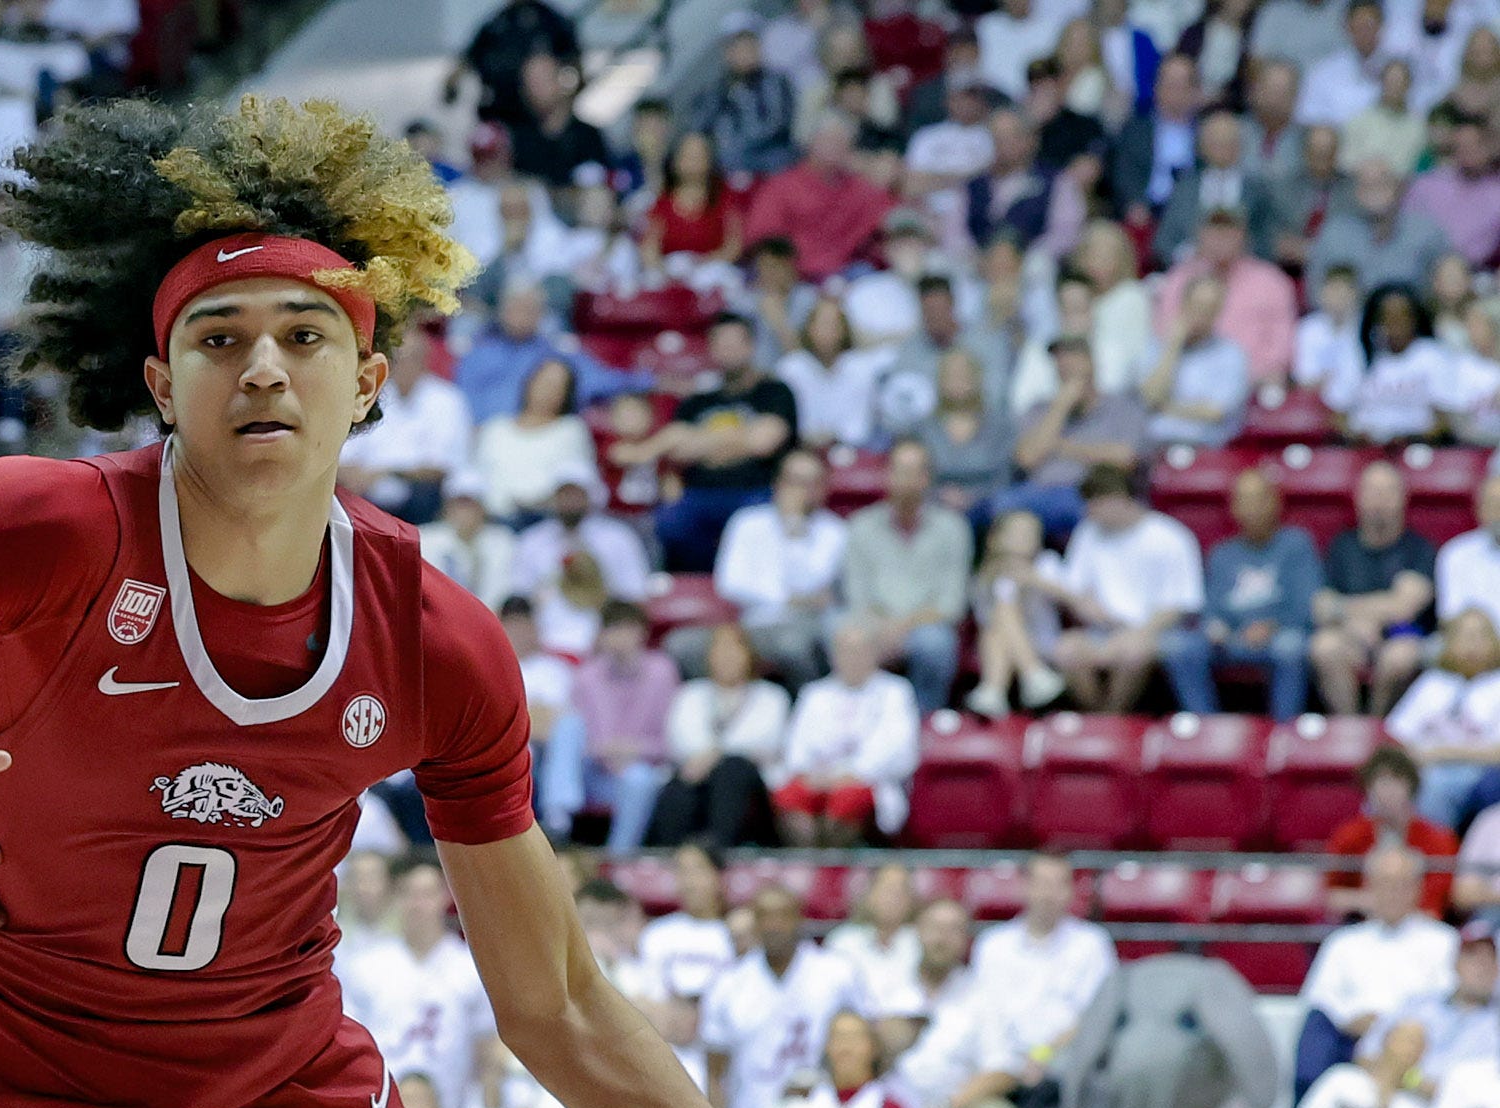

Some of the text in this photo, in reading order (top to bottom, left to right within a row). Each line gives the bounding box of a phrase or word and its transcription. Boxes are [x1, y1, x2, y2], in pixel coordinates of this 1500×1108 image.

[120, 590, 157, 616] 100
[345, 698, 384, 745] SEC
[123, 841, 238, 972] 0
